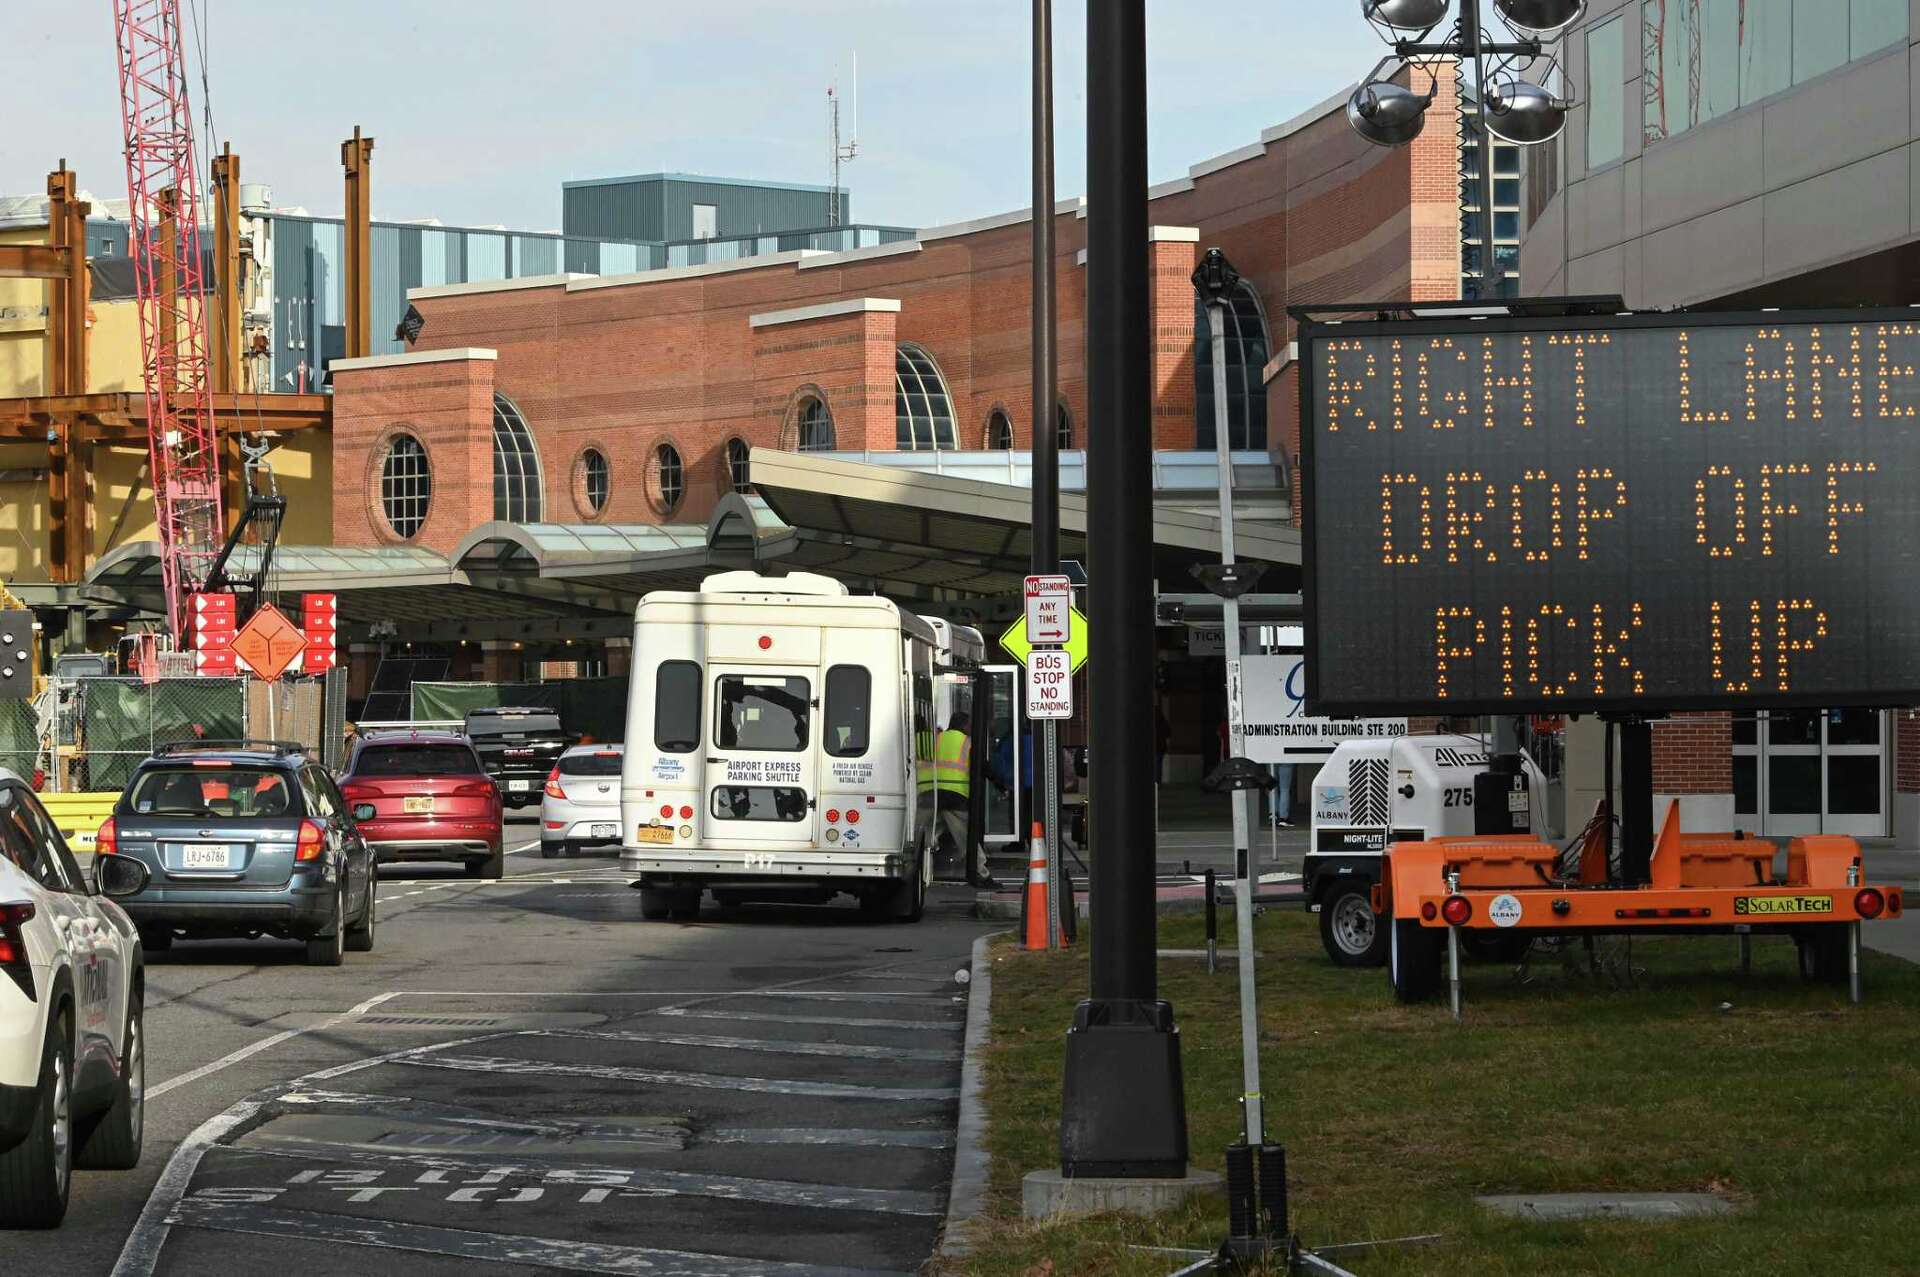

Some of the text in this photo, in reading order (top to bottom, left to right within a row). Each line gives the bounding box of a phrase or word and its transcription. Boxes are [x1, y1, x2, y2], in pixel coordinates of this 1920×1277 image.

[1327, 325, 1920, 432] RIGHT LANE
[1381, 461, 1878, 565] DROP OFF
[1026, 581, 1068, 594] NO STANDING
[1039, 602, 1057, 612] ANY
[1038, 615, 1058, 624] TIME
[1193, 631, 1225, 641] TICK
[1436, 597, 1828, 698] PICK UP
[1036, 657, 1061, 669] BUS
[1033, 672, 1065, 684] STOP
[1040, 687, 1058, 699] NO
[1030, 701, 1069, 712] STANDING
[1243, 724, 1406, 736] ADMINISTRATION BUILDING STE 200
[1435, 747, 1491, 767] Allma
[727, 761, 801, 772] AIRPORT EXPRESS
[727, 771, 800, 782] PARKING SHUTTLE
[1443, 787, 1473, 807] 275
[1316, 811, 1349, 819] ALBANY
[1343, 834, 1384, 843] NIGHT-LITE
